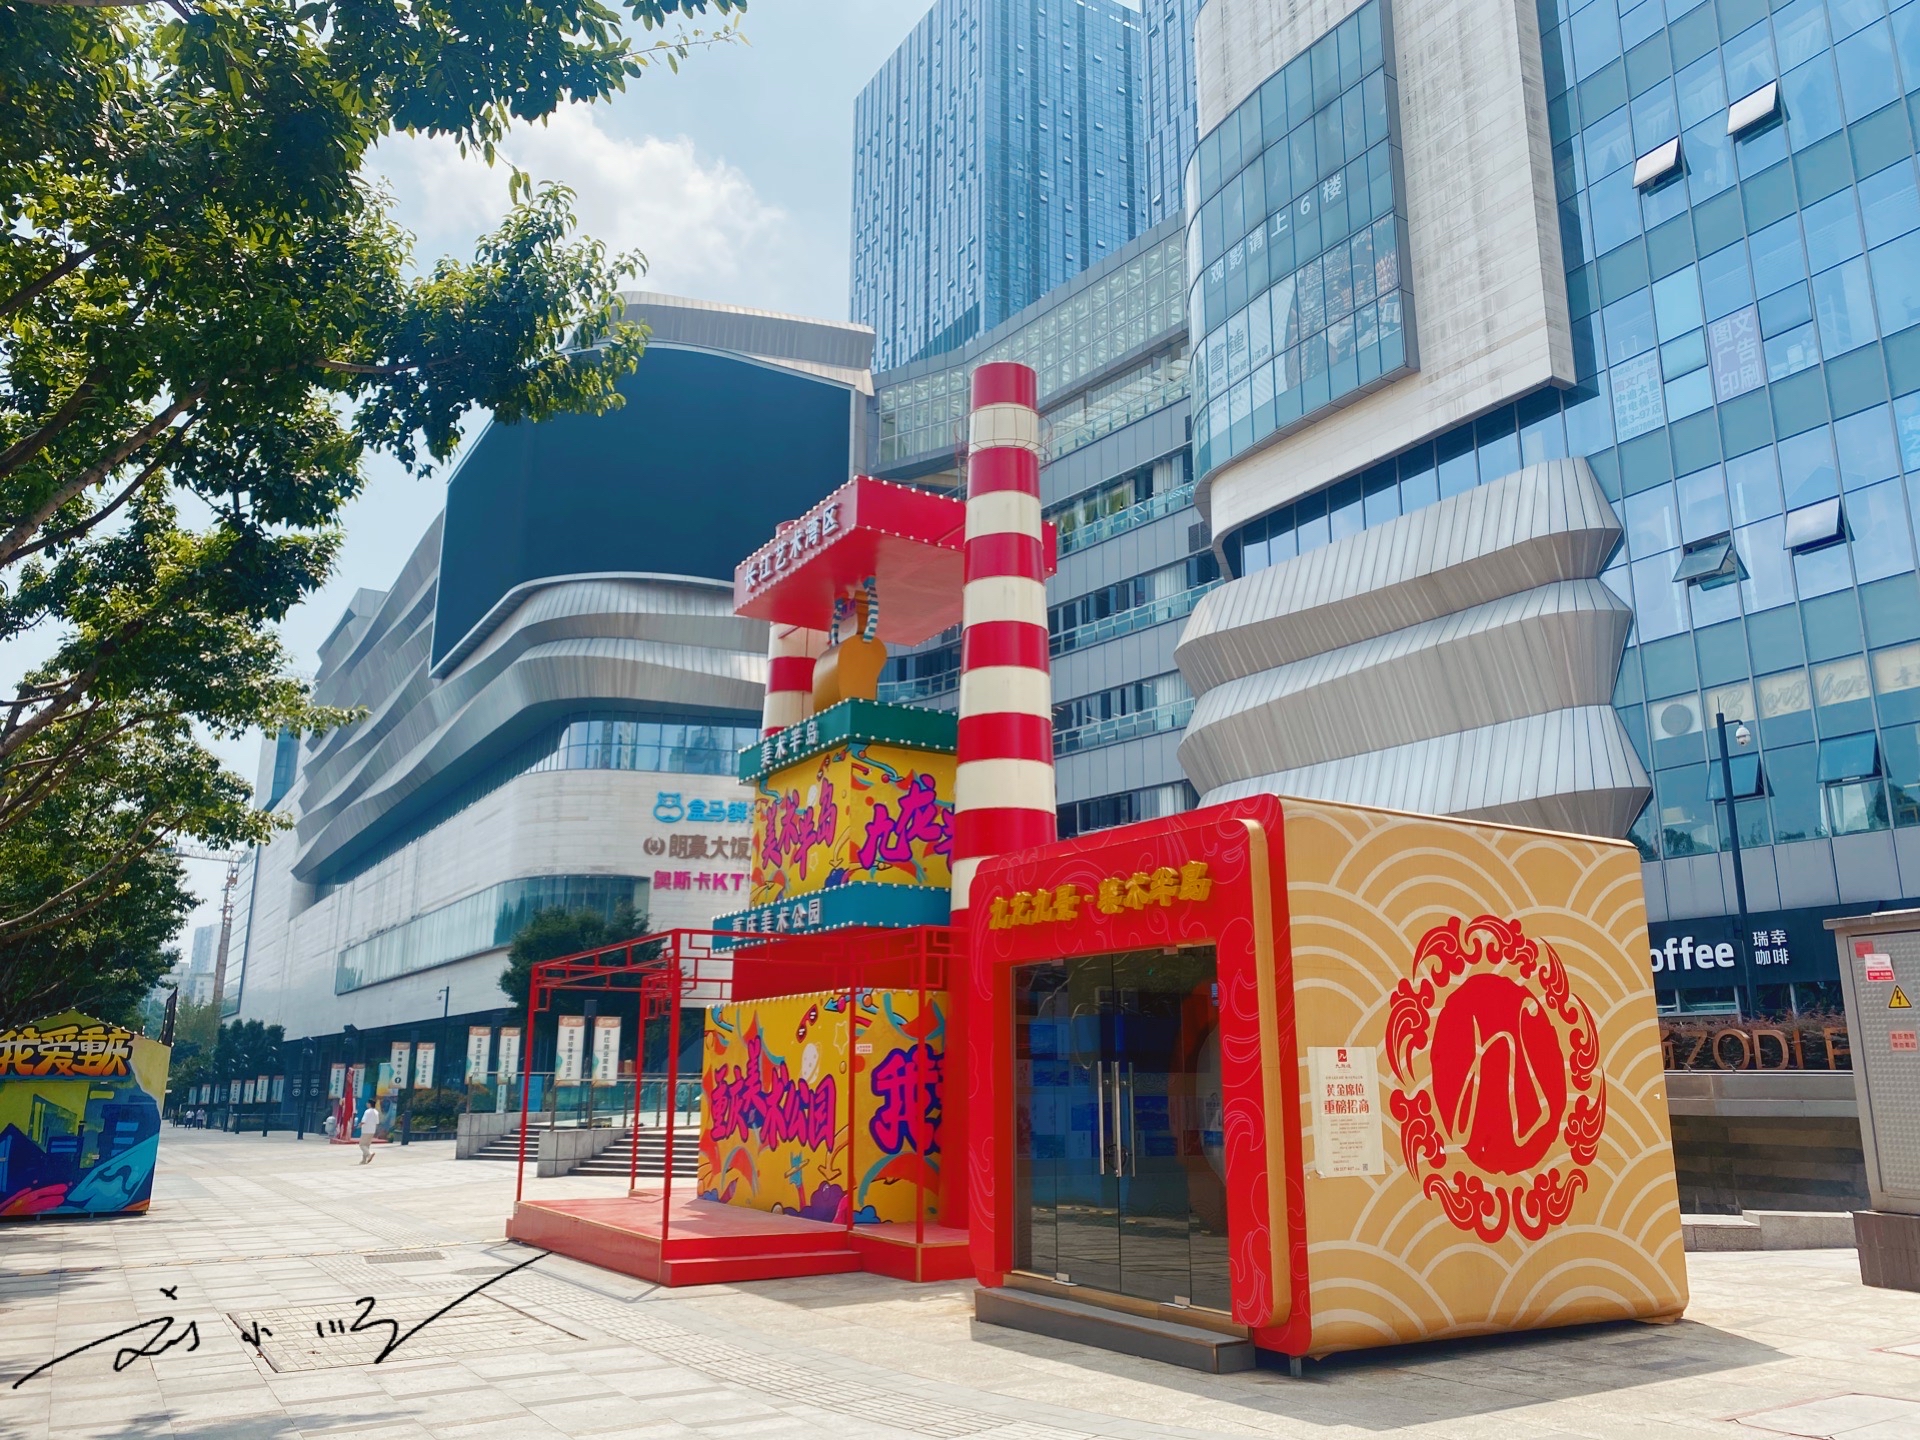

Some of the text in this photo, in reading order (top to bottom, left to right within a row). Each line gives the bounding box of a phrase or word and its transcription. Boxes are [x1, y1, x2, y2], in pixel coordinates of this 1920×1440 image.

[1210, 173, 1342, 284] 观影请上6楼
[1712, 312, 1754, 347] 图文
[1717, 338, 1757, 372] 广告
[1720, 361, 1760, 396] 印刷
[744, 502, 840, 592] 长江艺术湾区
[761, 720, 819, 769] 美术半岛
[1753, 930, 1787, 947] 瑞幸
[1755, 949, 1790, 966] 咖啡
[1324, 1099, 1370, 1115] 重磅招商
[1326, 1083, 1365, 1097] 黄金席位
